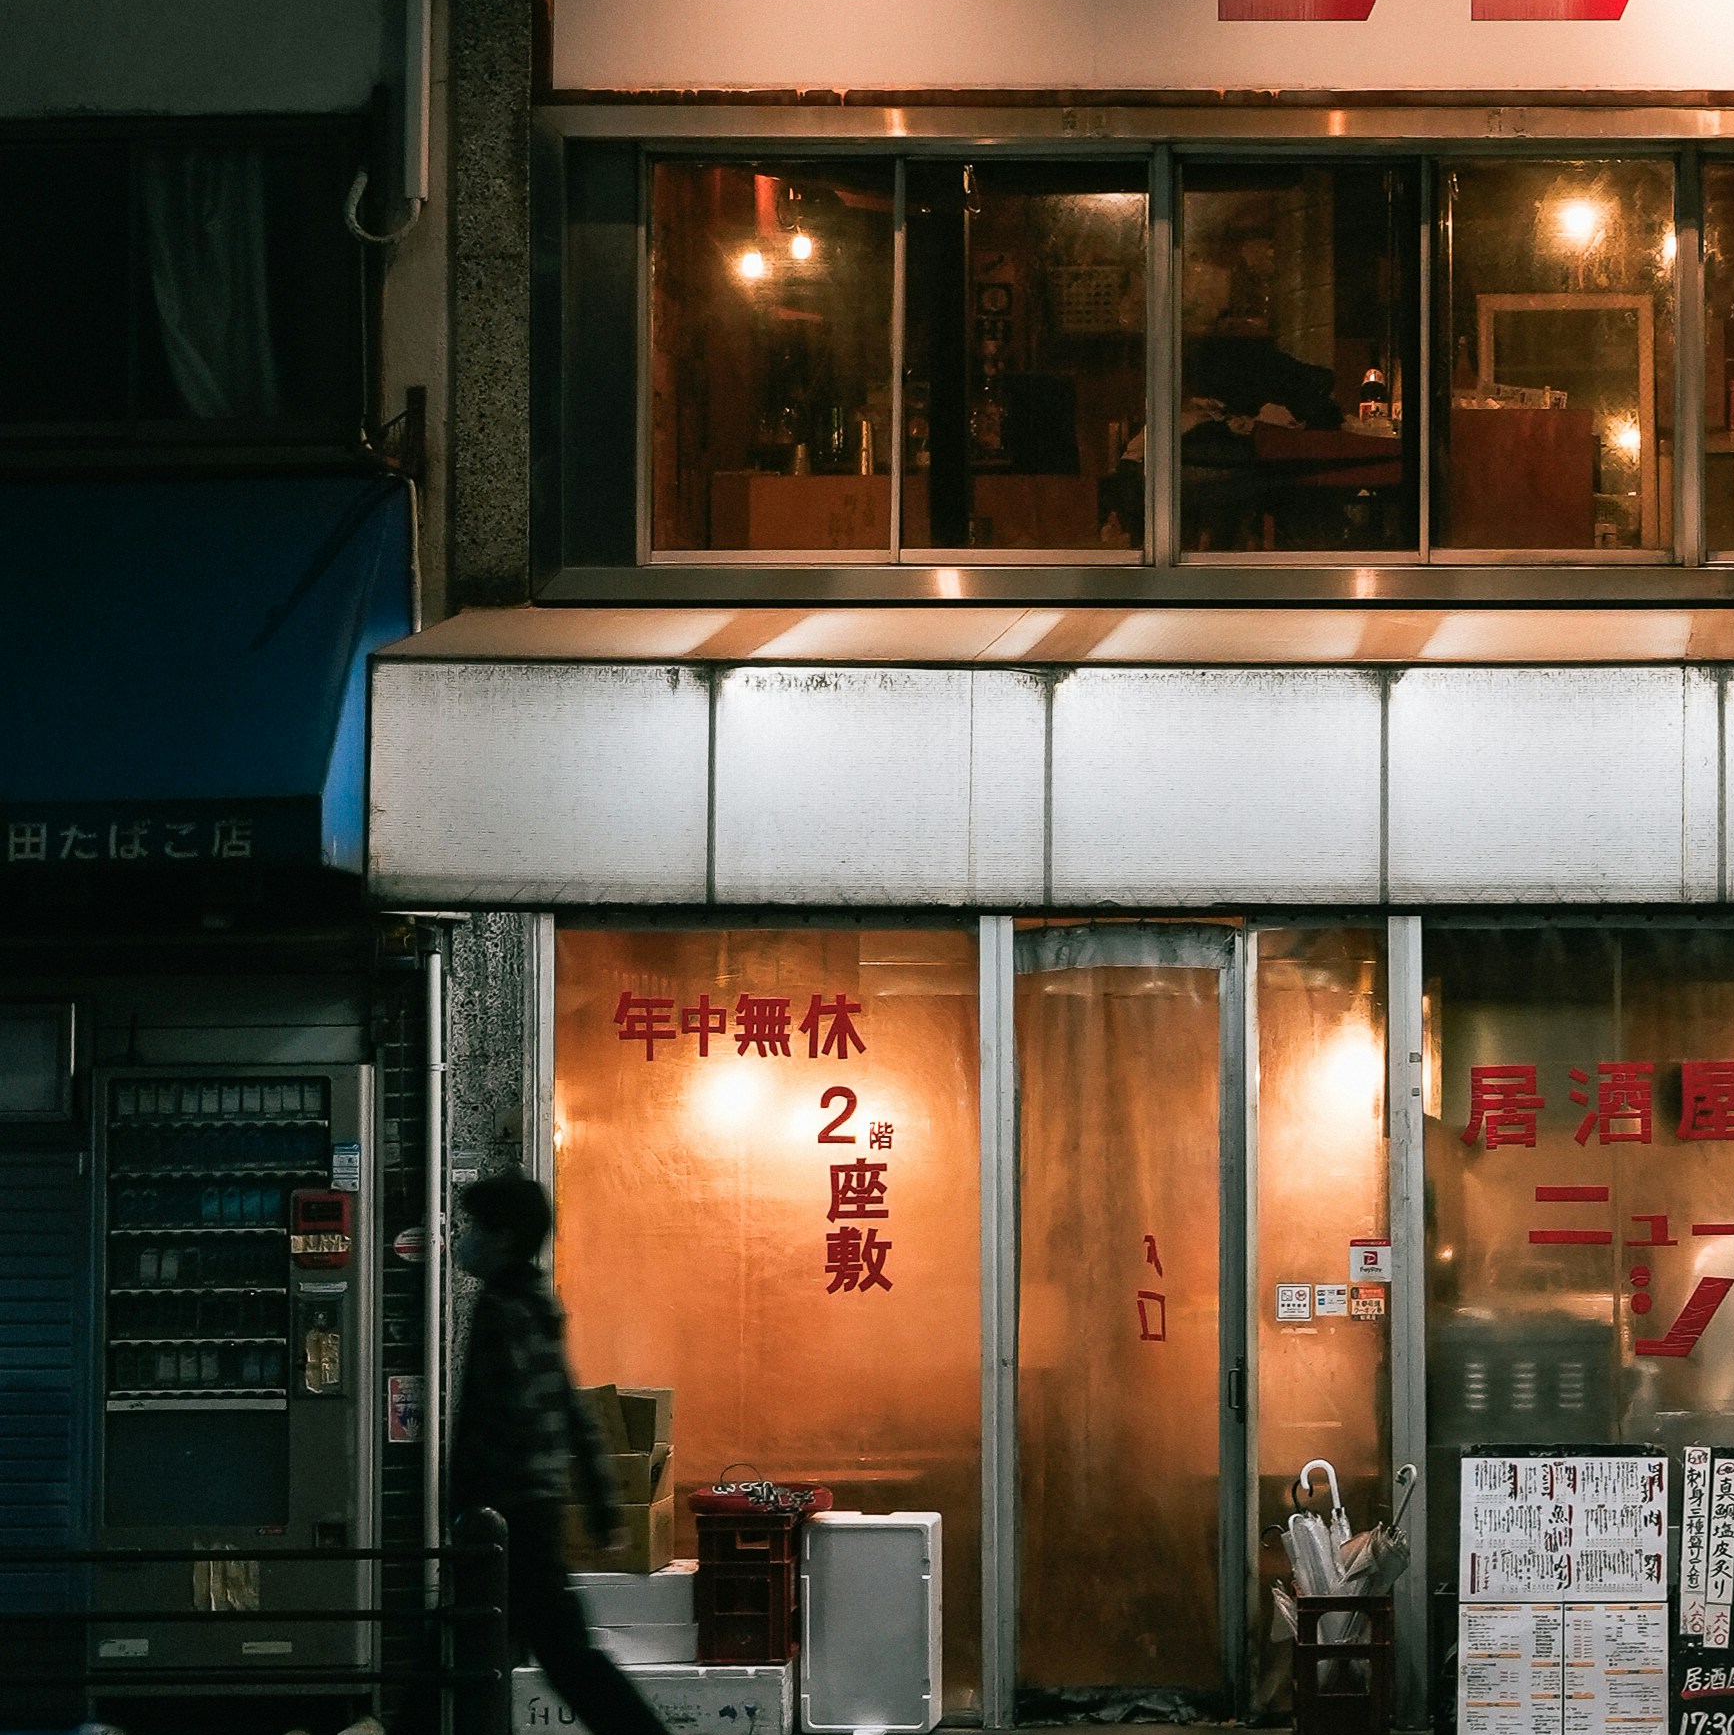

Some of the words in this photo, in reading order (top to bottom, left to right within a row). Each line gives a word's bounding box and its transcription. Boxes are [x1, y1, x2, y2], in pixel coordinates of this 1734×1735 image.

[7, 818, 254, 863] 田たばこ店
[612, 991, 867, 1062] 年中無休
